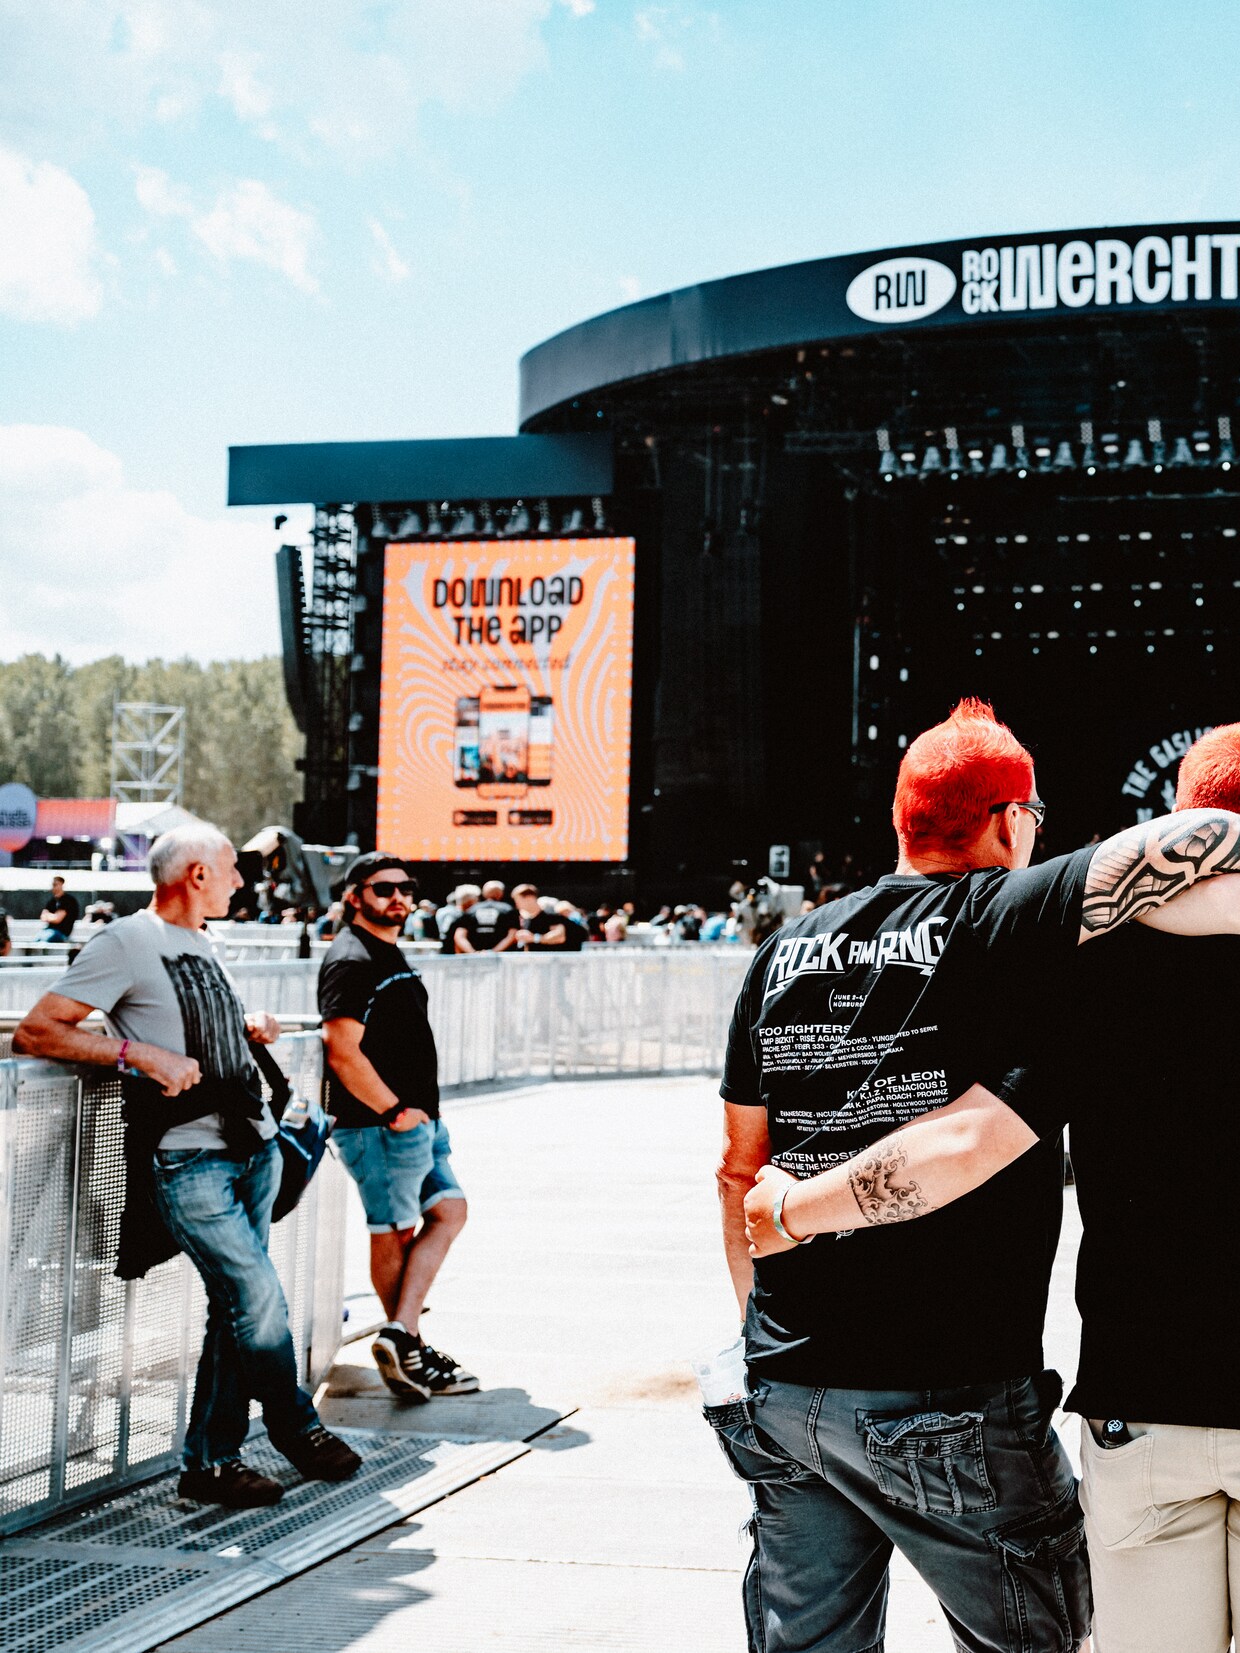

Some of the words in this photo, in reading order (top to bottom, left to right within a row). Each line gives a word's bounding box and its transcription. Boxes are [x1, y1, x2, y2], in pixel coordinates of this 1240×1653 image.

[874, 270, 926, 312] RW
[1121, 759, 1158, 799] THE
[847, 940, 878, 965] AM
[759, 1026, 783, 1037] FOO
[784, 1024, 852, 1035] FIGHTERS
[919, 1025, 939, 1034] SERVE
[799, 1035, 816, 1043] RISE
[874, 1076, 897, 1089] OF
[901, 1069, 946, 1084] LEON
[886, 1081, 938, 1094] TENACIOUS
[939, 1080, 947, 1088] D
[866, 1095, 886, 1106] PAPA
[886, 1092, 912, 1101] ROACH
[916, 1088, 949, 1098] PROVINZ
[805, 1162, 820, 1171] THE
